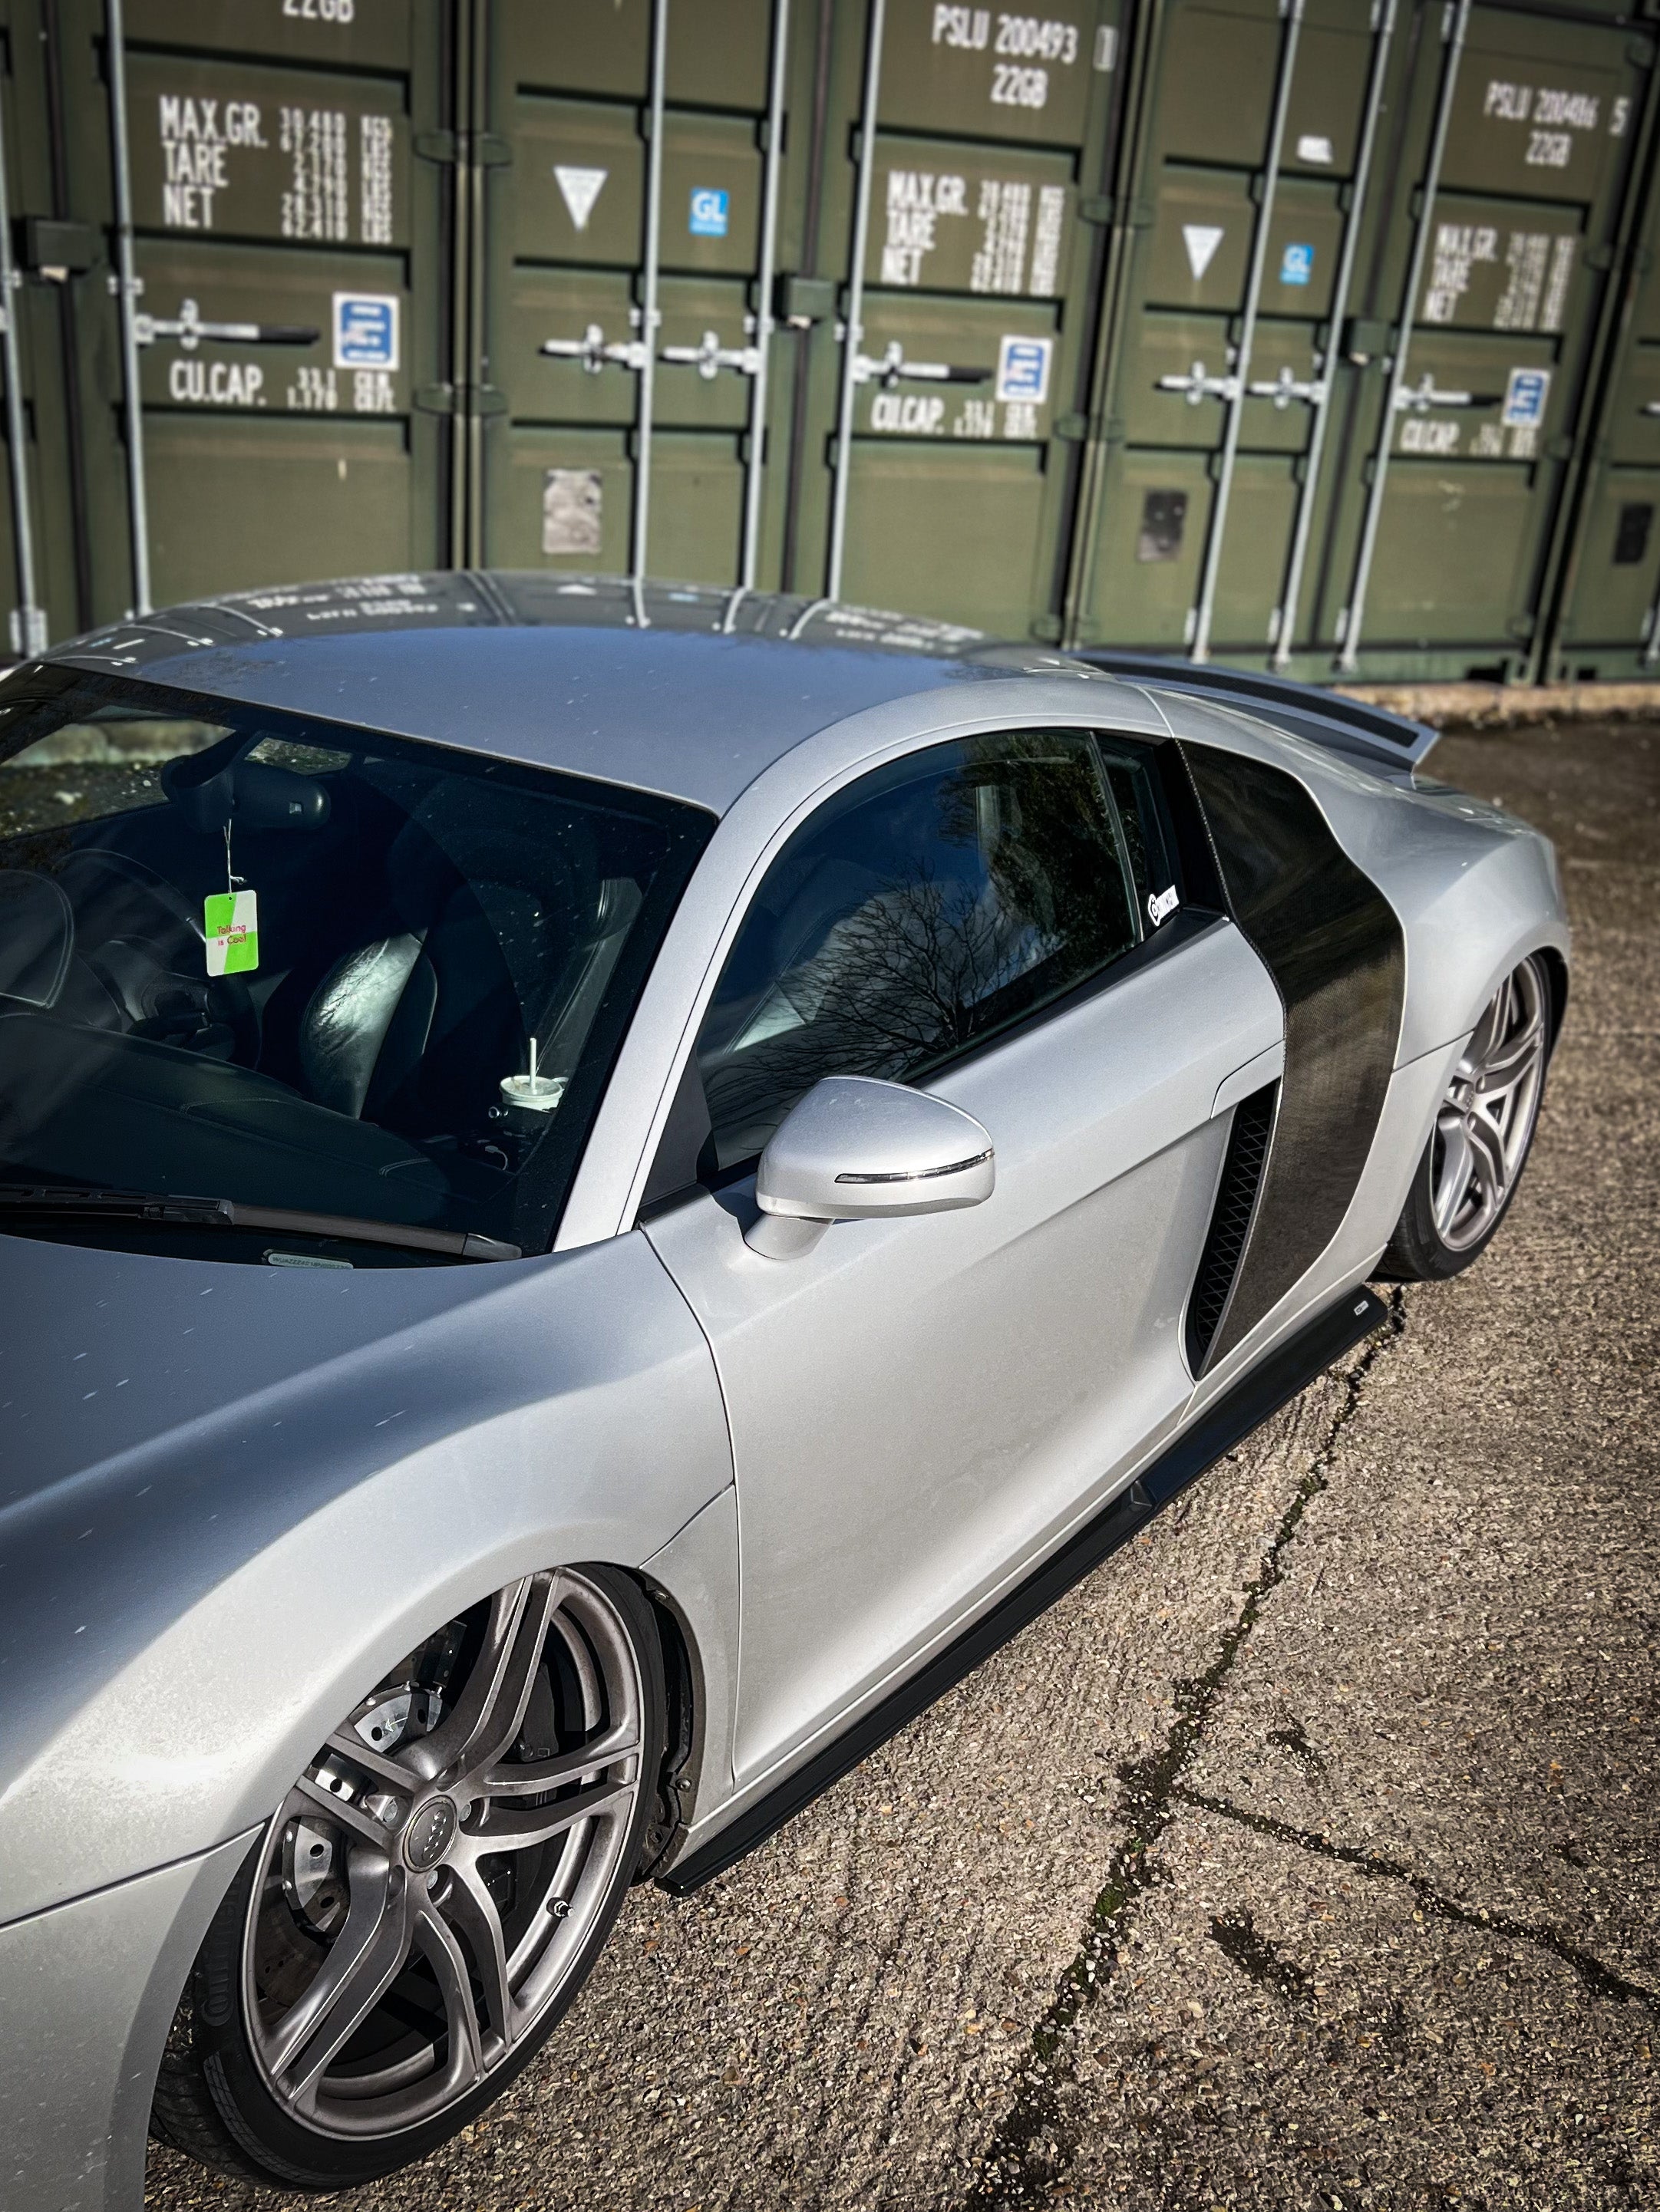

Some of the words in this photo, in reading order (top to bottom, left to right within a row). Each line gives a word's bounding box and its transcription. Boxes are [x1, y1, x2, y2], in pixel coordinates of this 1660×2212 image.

[932, 3, 990, 51] PSLU
[990, 64, 1048, 109] 22GB
[1609, 96, 1631, 137] 5
[162, 140, 229, 188] TARE
[163, 184, 215, 229] NET
[692, 191, 726, 222] GL
[880, 246, 923, 286] NET
[217, 925, 246, 935] Talking
[227, 935, 246, 944] Cool
